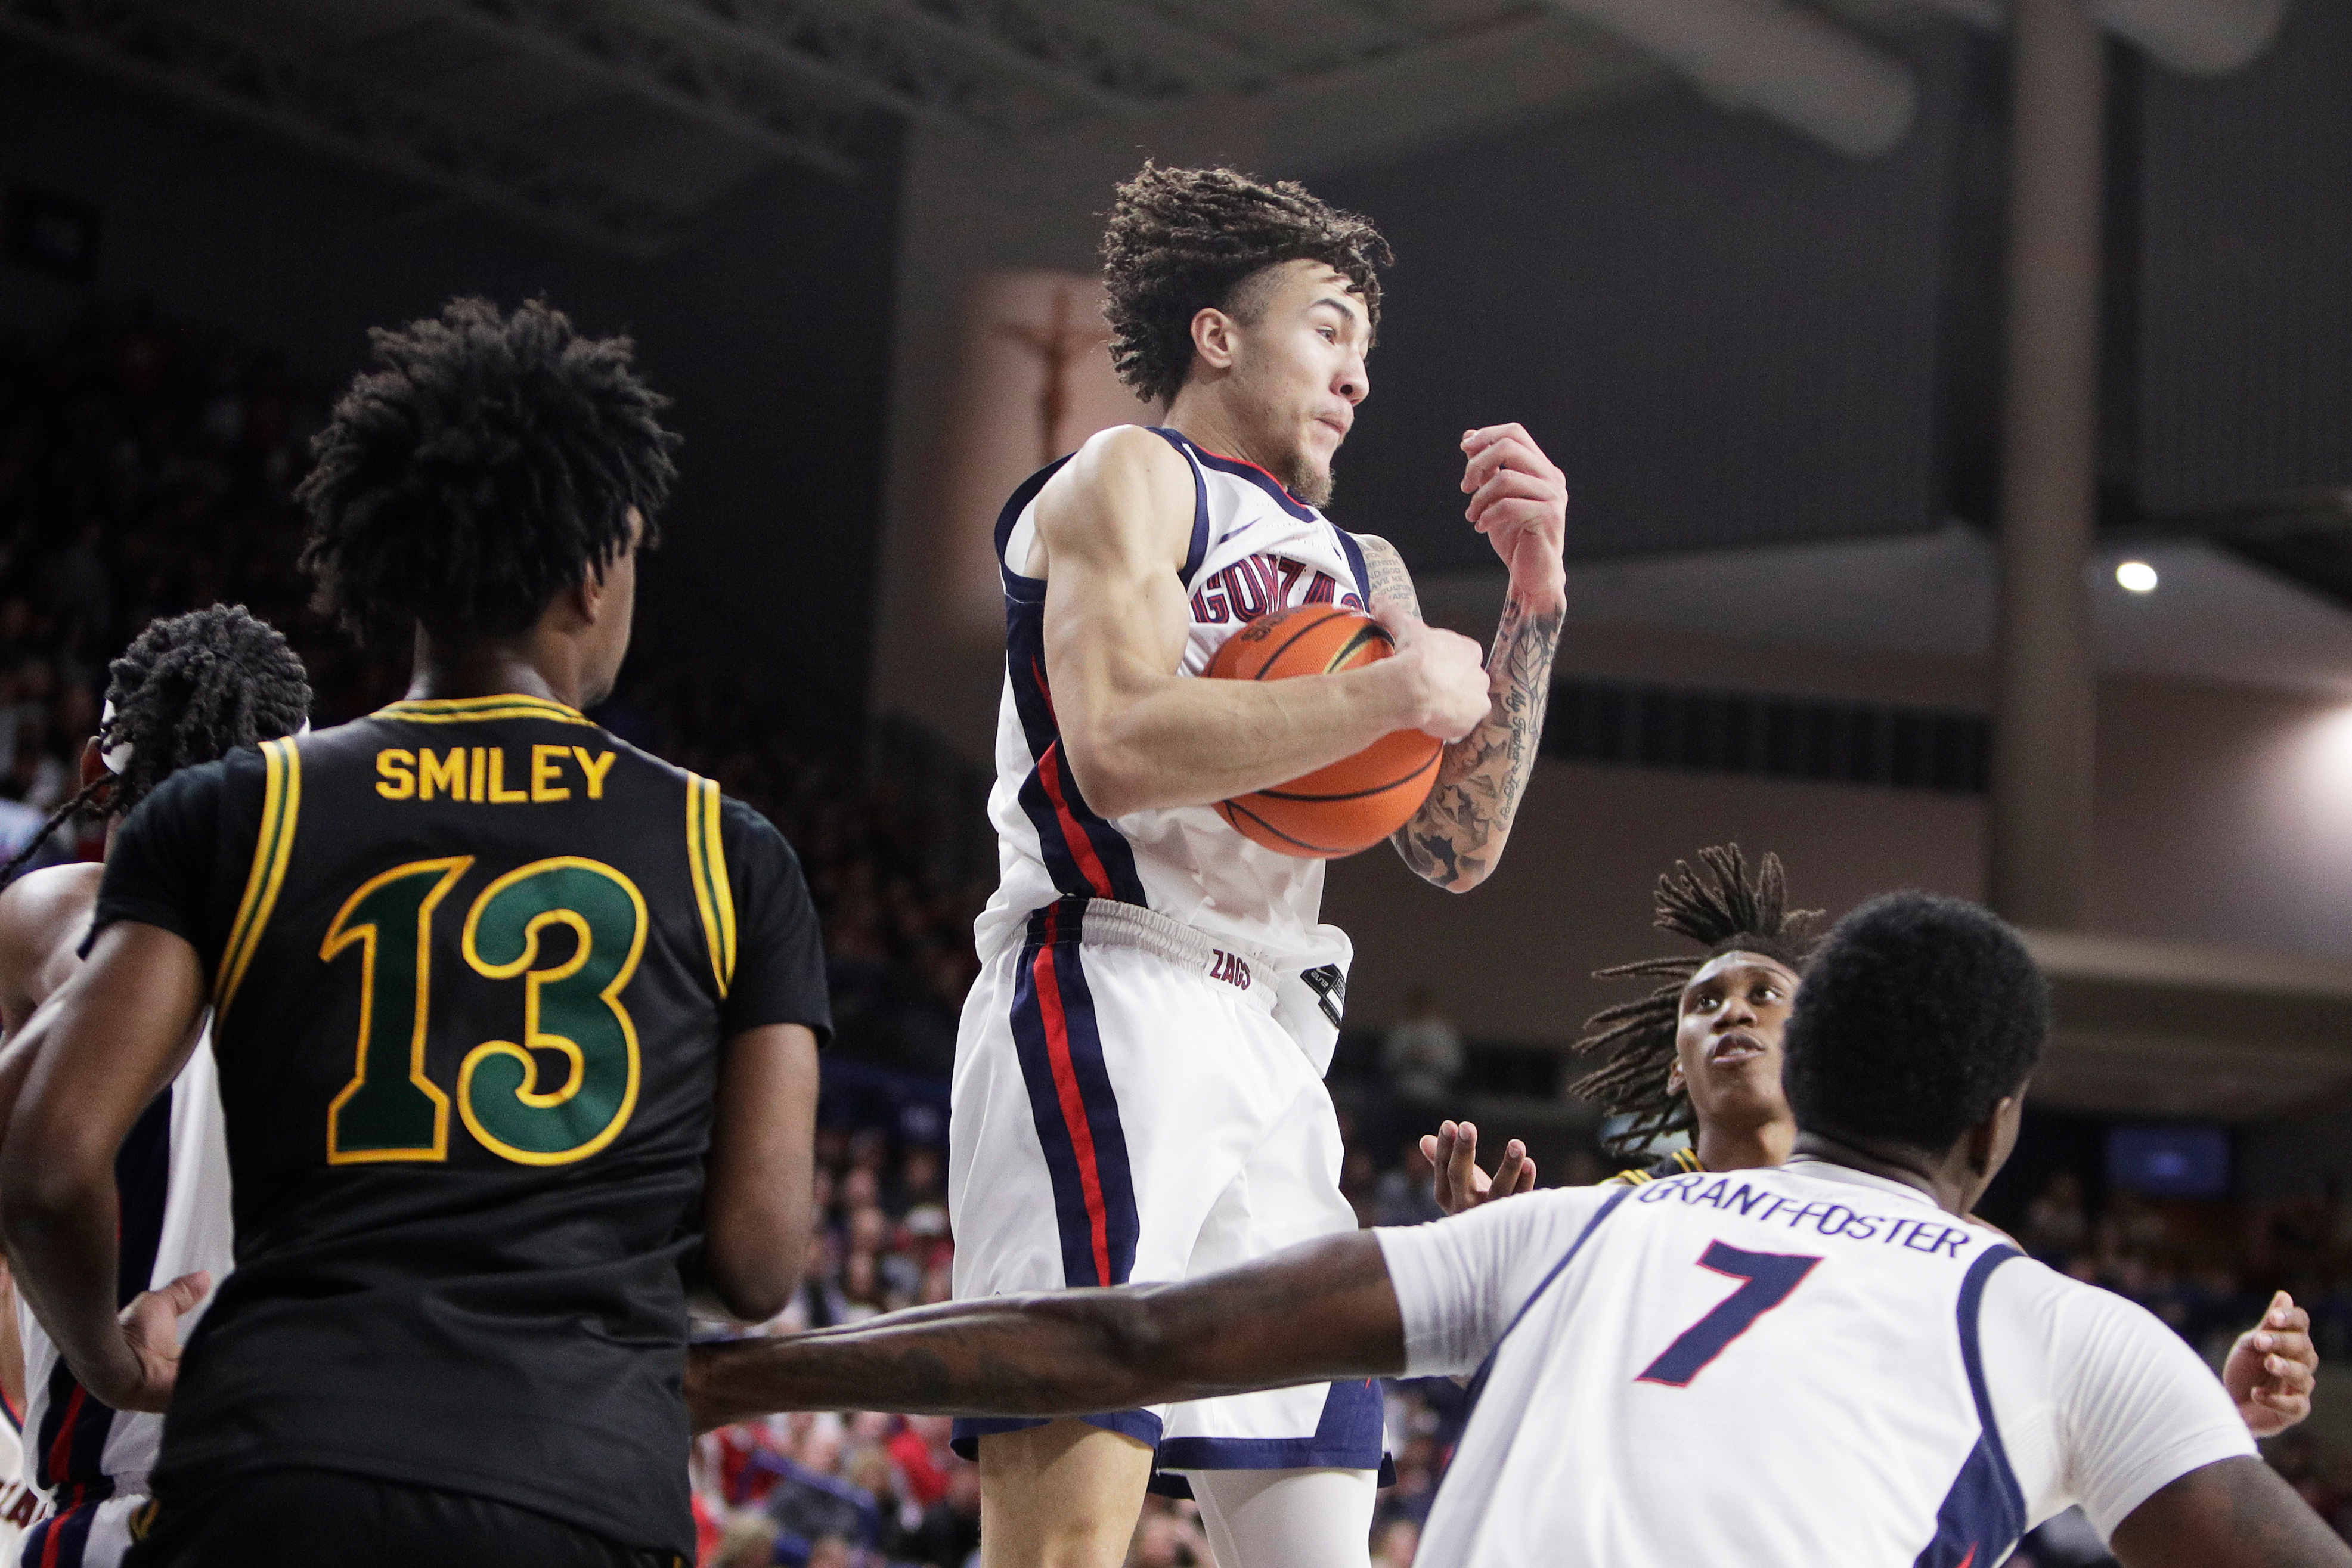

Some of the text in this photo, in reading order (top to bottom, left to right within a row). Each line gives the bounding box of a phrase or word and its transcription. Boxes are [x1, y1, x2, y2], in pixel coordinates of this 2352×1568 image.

[1191, 554, 1365, 624] GONZA
[1371, 576, 1390, 591] AVE
[376, 744, 616, 803] SMILEY
[1210, 949, 1251, 990] ZAGS
[319, 855, 648, 1166] 13
[1639, 1176, 1971, 1258] GRANT-FOSTER
[1634, 1238, 1825, 1389] 7
